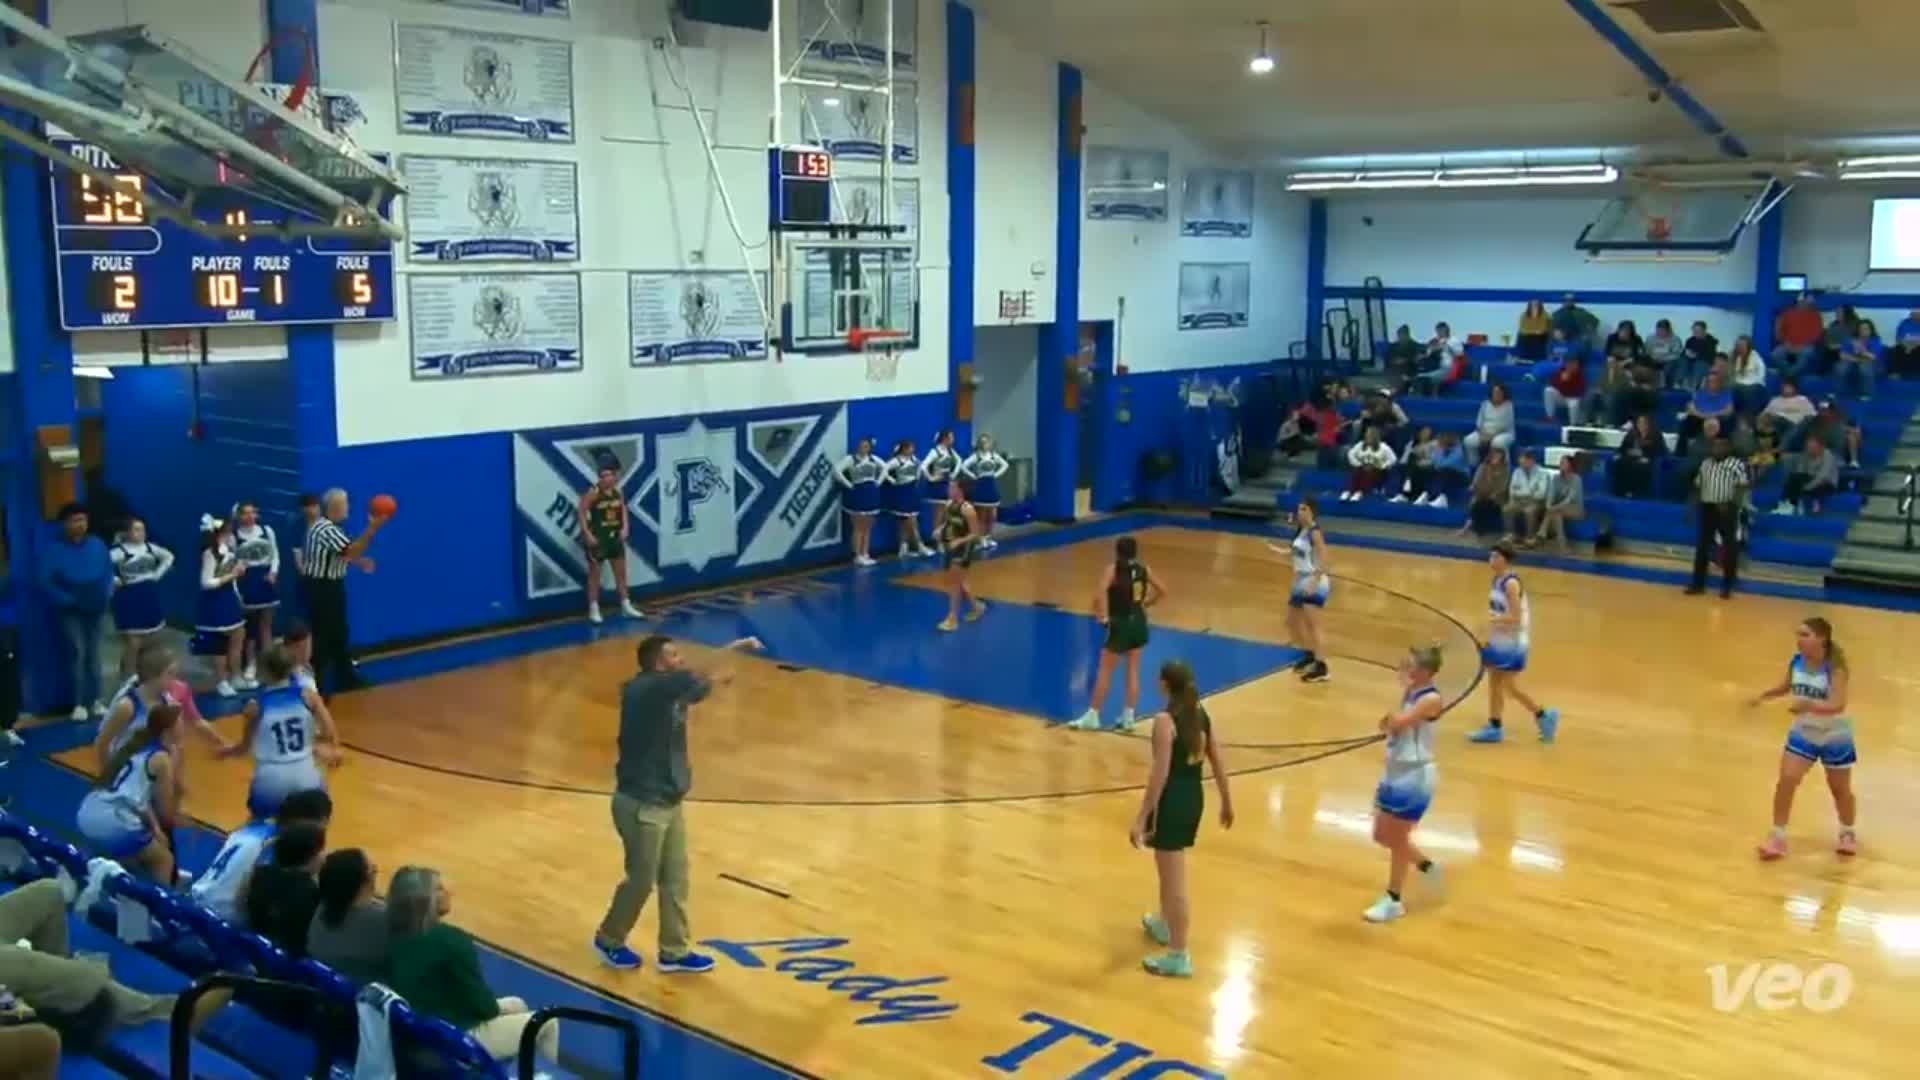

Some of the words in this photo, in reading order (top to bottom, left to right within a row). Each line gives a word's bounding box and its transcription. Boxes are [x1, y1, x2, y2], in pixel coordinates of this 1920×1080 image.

[91, 256, 133, 271] FOULS
[191, 256, 242, 271] PLAYER
[253, 256, 291, 271] FOULS
[336, 256, 370, 270] FOULS
[114, 275, 136, 309] 2
[352, 273, 372, 304] 5
[101, 312, 130, 324] WON
[226, 309, 255, 321] GAME
[343, 307, 366, 318] WON
[779, 452, 832, 529] TIGERS
[271, 717, 304, 755] 15
[696, 936, 960, 1026] Lady
